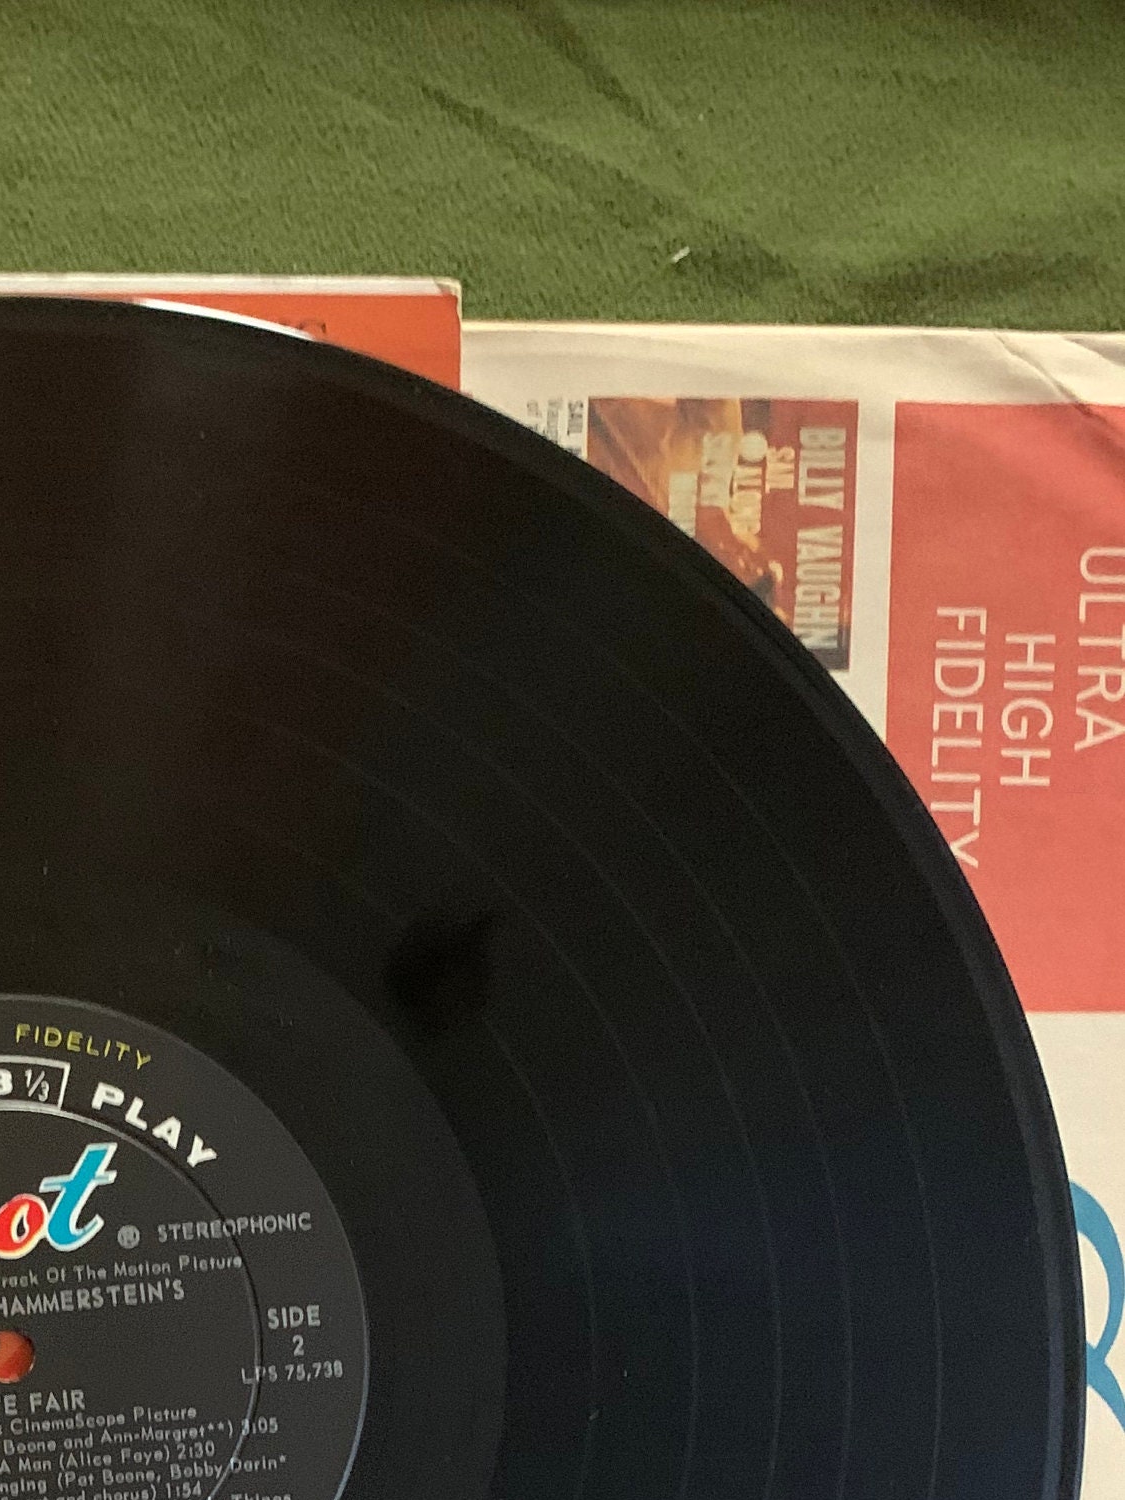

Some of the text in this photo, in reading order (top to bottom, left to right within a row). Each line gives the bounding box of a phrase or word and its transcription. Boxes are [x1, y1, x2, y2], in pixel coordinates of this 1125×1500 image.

[792, 427, 846, 650] BILLY VAUGHN
[1074, 547, 1125, 752] ULTRA
[1000, 633, 1055, 788] HIGH
[930, 606, 987, 868] FIDELITY
[16, 1024, 151, 1070] FIDELITY
[91, 1082, 217, 1168] PLAY
[158, 1212, 312, 1243] STEREOPHONIC
[47, 1266, 65, 1284] Of
[75, 1265, 106, 1282] The
[114, 1260, 170, 1278] Motion
[179, 1255, 242, 1272] Picture
[267, 1305, 321, 1329] SIDE
[292, 1334, 304, 1356] 2
[30, 1389, 85, 1413] FAIR
[10, 1414, 125, 1436] CinemaScope
[133, 1406, 197, 1422] Picture
[0, 1459, 11, 1475] A
[19, 1458, 51, 1472] Man
[59, 1451, 111, 1469] (Alice
[121, 1444, 170, 1465] Faye)
[177, 1440, 214, 1460] 2:30
[3, 1438, 56, 1455] Boone
[64, 1432, 93, 1449] and
[57, 1471, 95, 1490] (Pat
[102, 1469, 161, 1486] Boone,
[170, 1460, 223, 1480] Bobby
